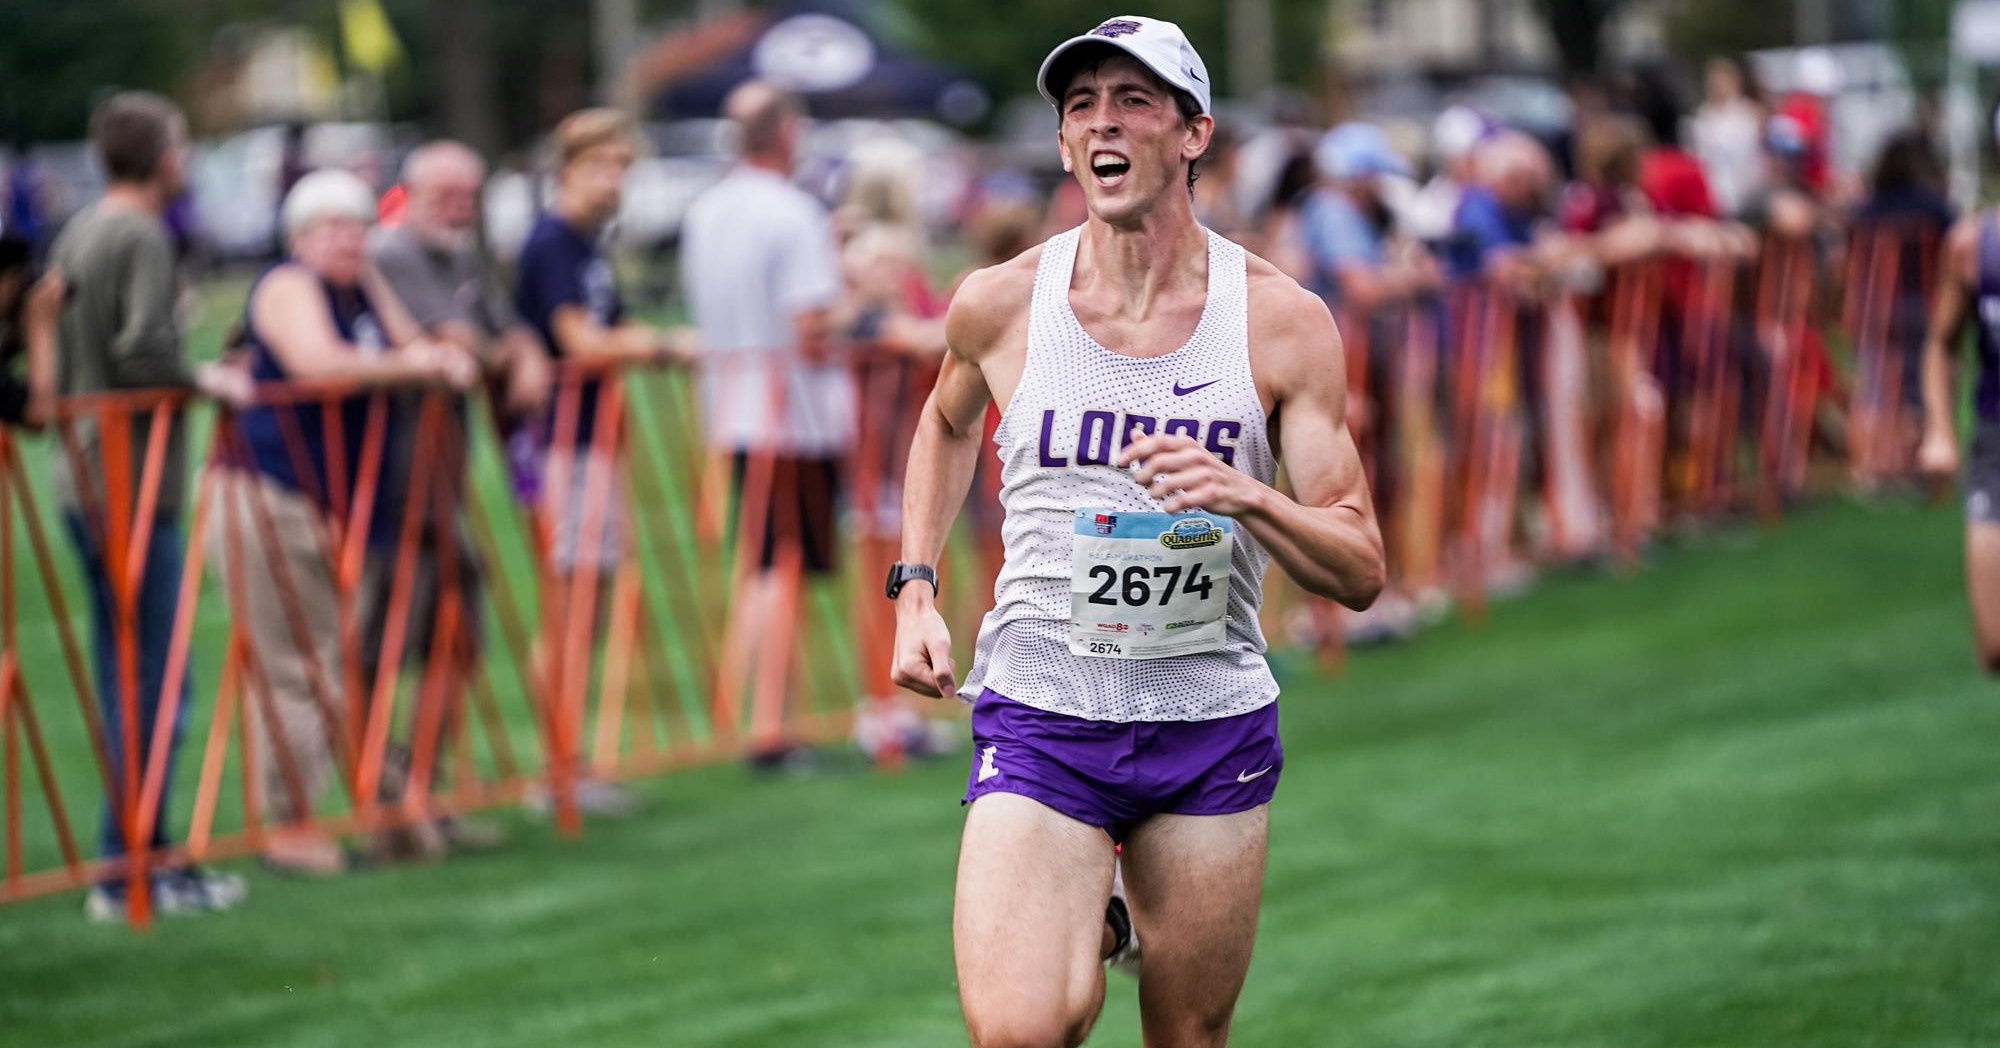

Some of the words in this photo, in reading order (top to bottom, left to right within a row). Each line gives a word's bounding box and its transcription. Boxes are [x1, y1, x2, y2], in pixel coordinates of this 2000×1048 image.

[1163, 534, 1191, 545] QUAD
[1194, 531, 1221, 543] CITIES
[1088, 563, 1213, 607] 2674
[1090, 642, 1122, 655] 2674
